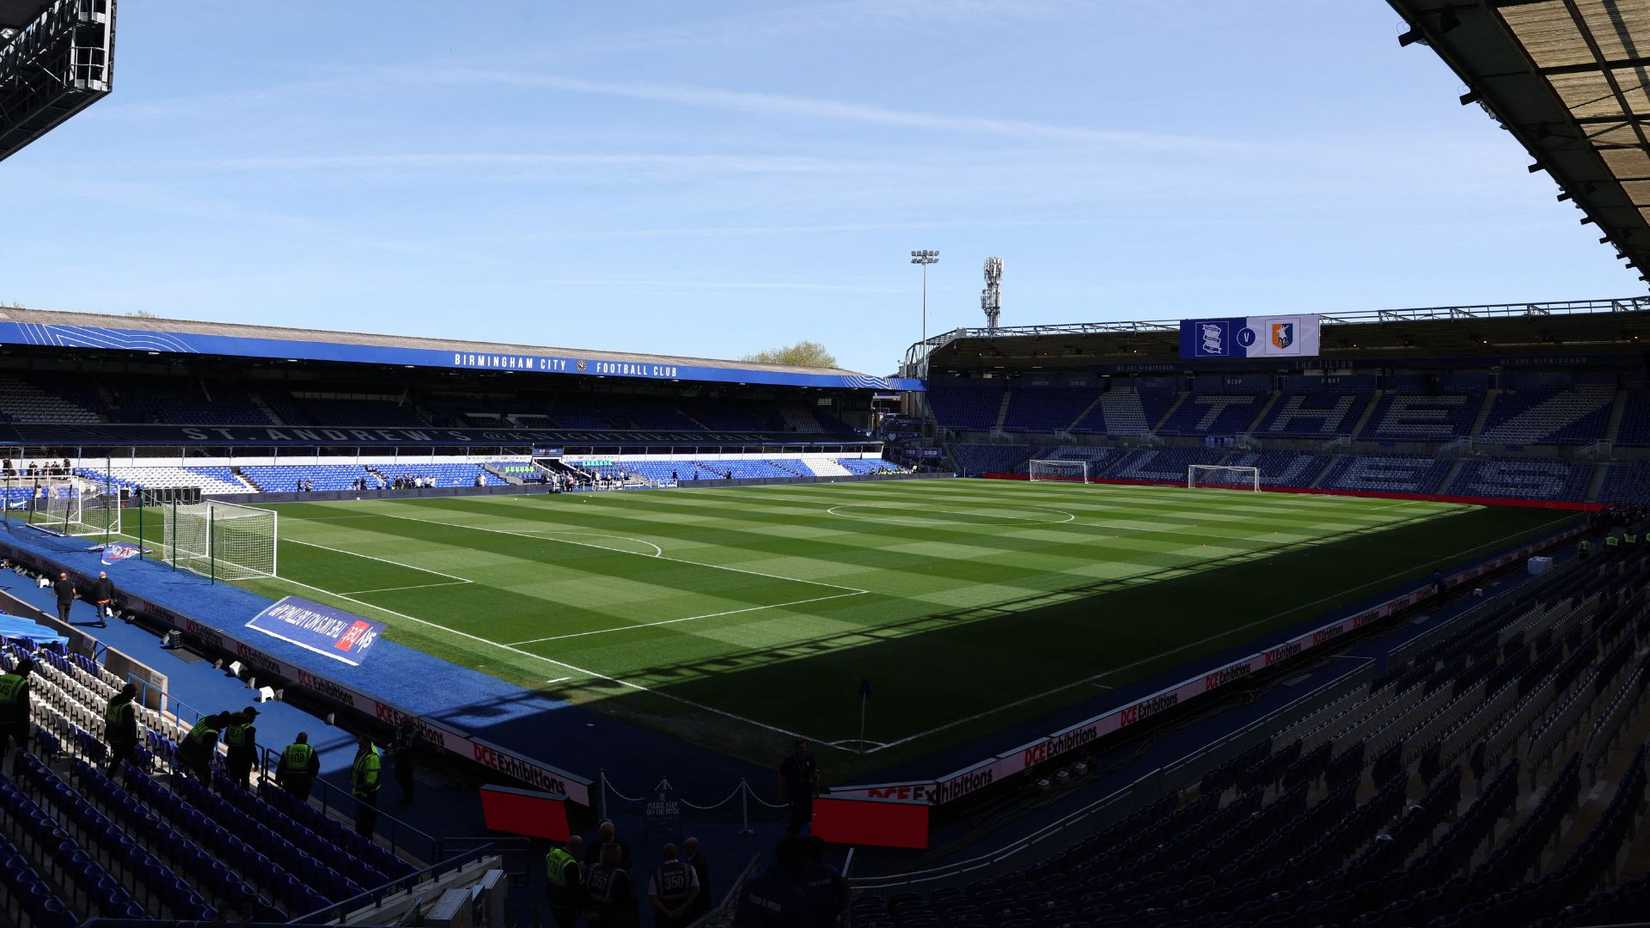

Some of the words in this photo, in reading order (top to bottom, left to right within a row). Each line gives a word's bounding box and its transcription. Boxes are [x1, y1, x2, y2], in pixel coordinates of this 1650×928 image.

[455, 353, 533, 369] BIRMINGHAM
[540, 358, 567, 371] CITY
[596, 362, 648, 376] FOOTBALL
[653, 366, 678, 378] CLUB
[265, 428, 472, 442] ANDREW'S
[474, 743, 498, 769] DCE
[1024, 744, 1047, 767] DCE
[1047, 725, 1098, 757] Exhibitions
